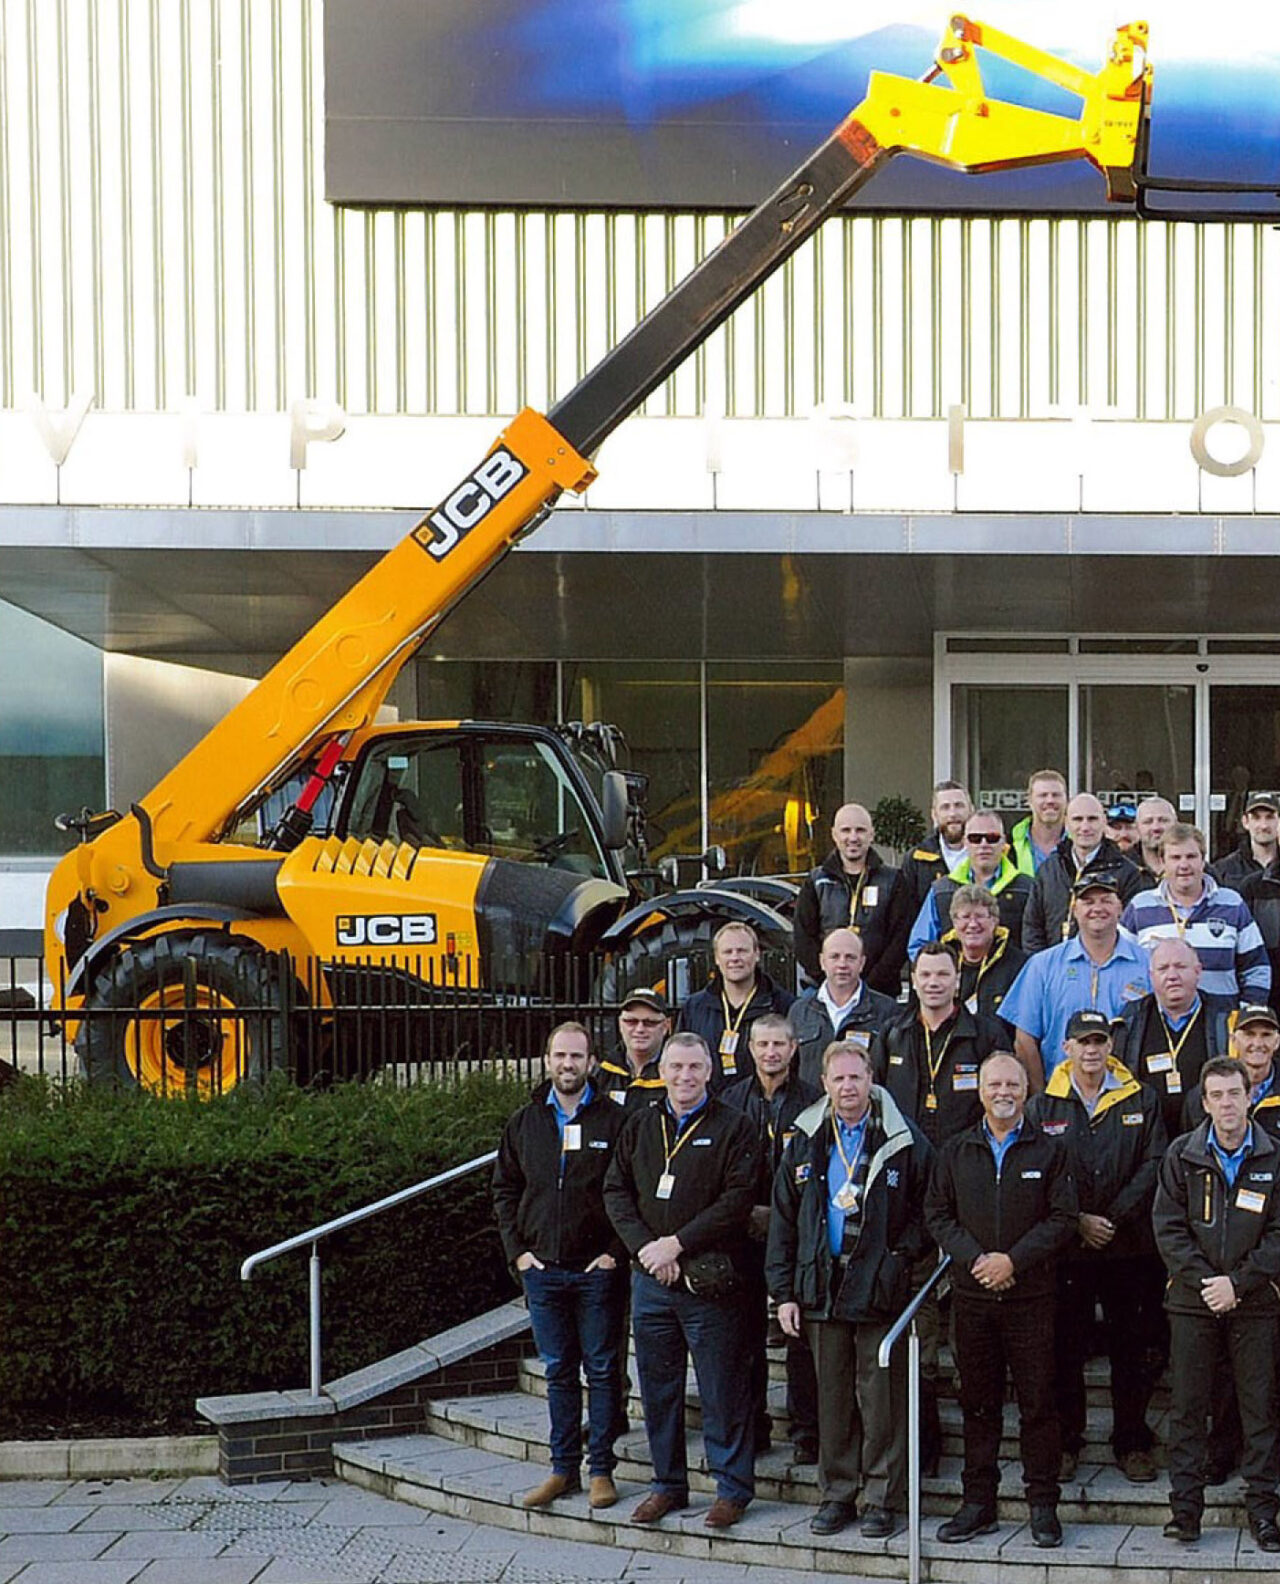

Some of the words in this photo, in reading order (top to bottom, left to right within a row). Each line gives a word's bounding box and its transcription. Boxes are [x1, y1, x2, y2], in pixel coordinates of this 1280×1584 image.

[28, 394, 347, 470] VIP
[425, 450, 525, 559] JCB
[338, 916, 435, 945] JCB
